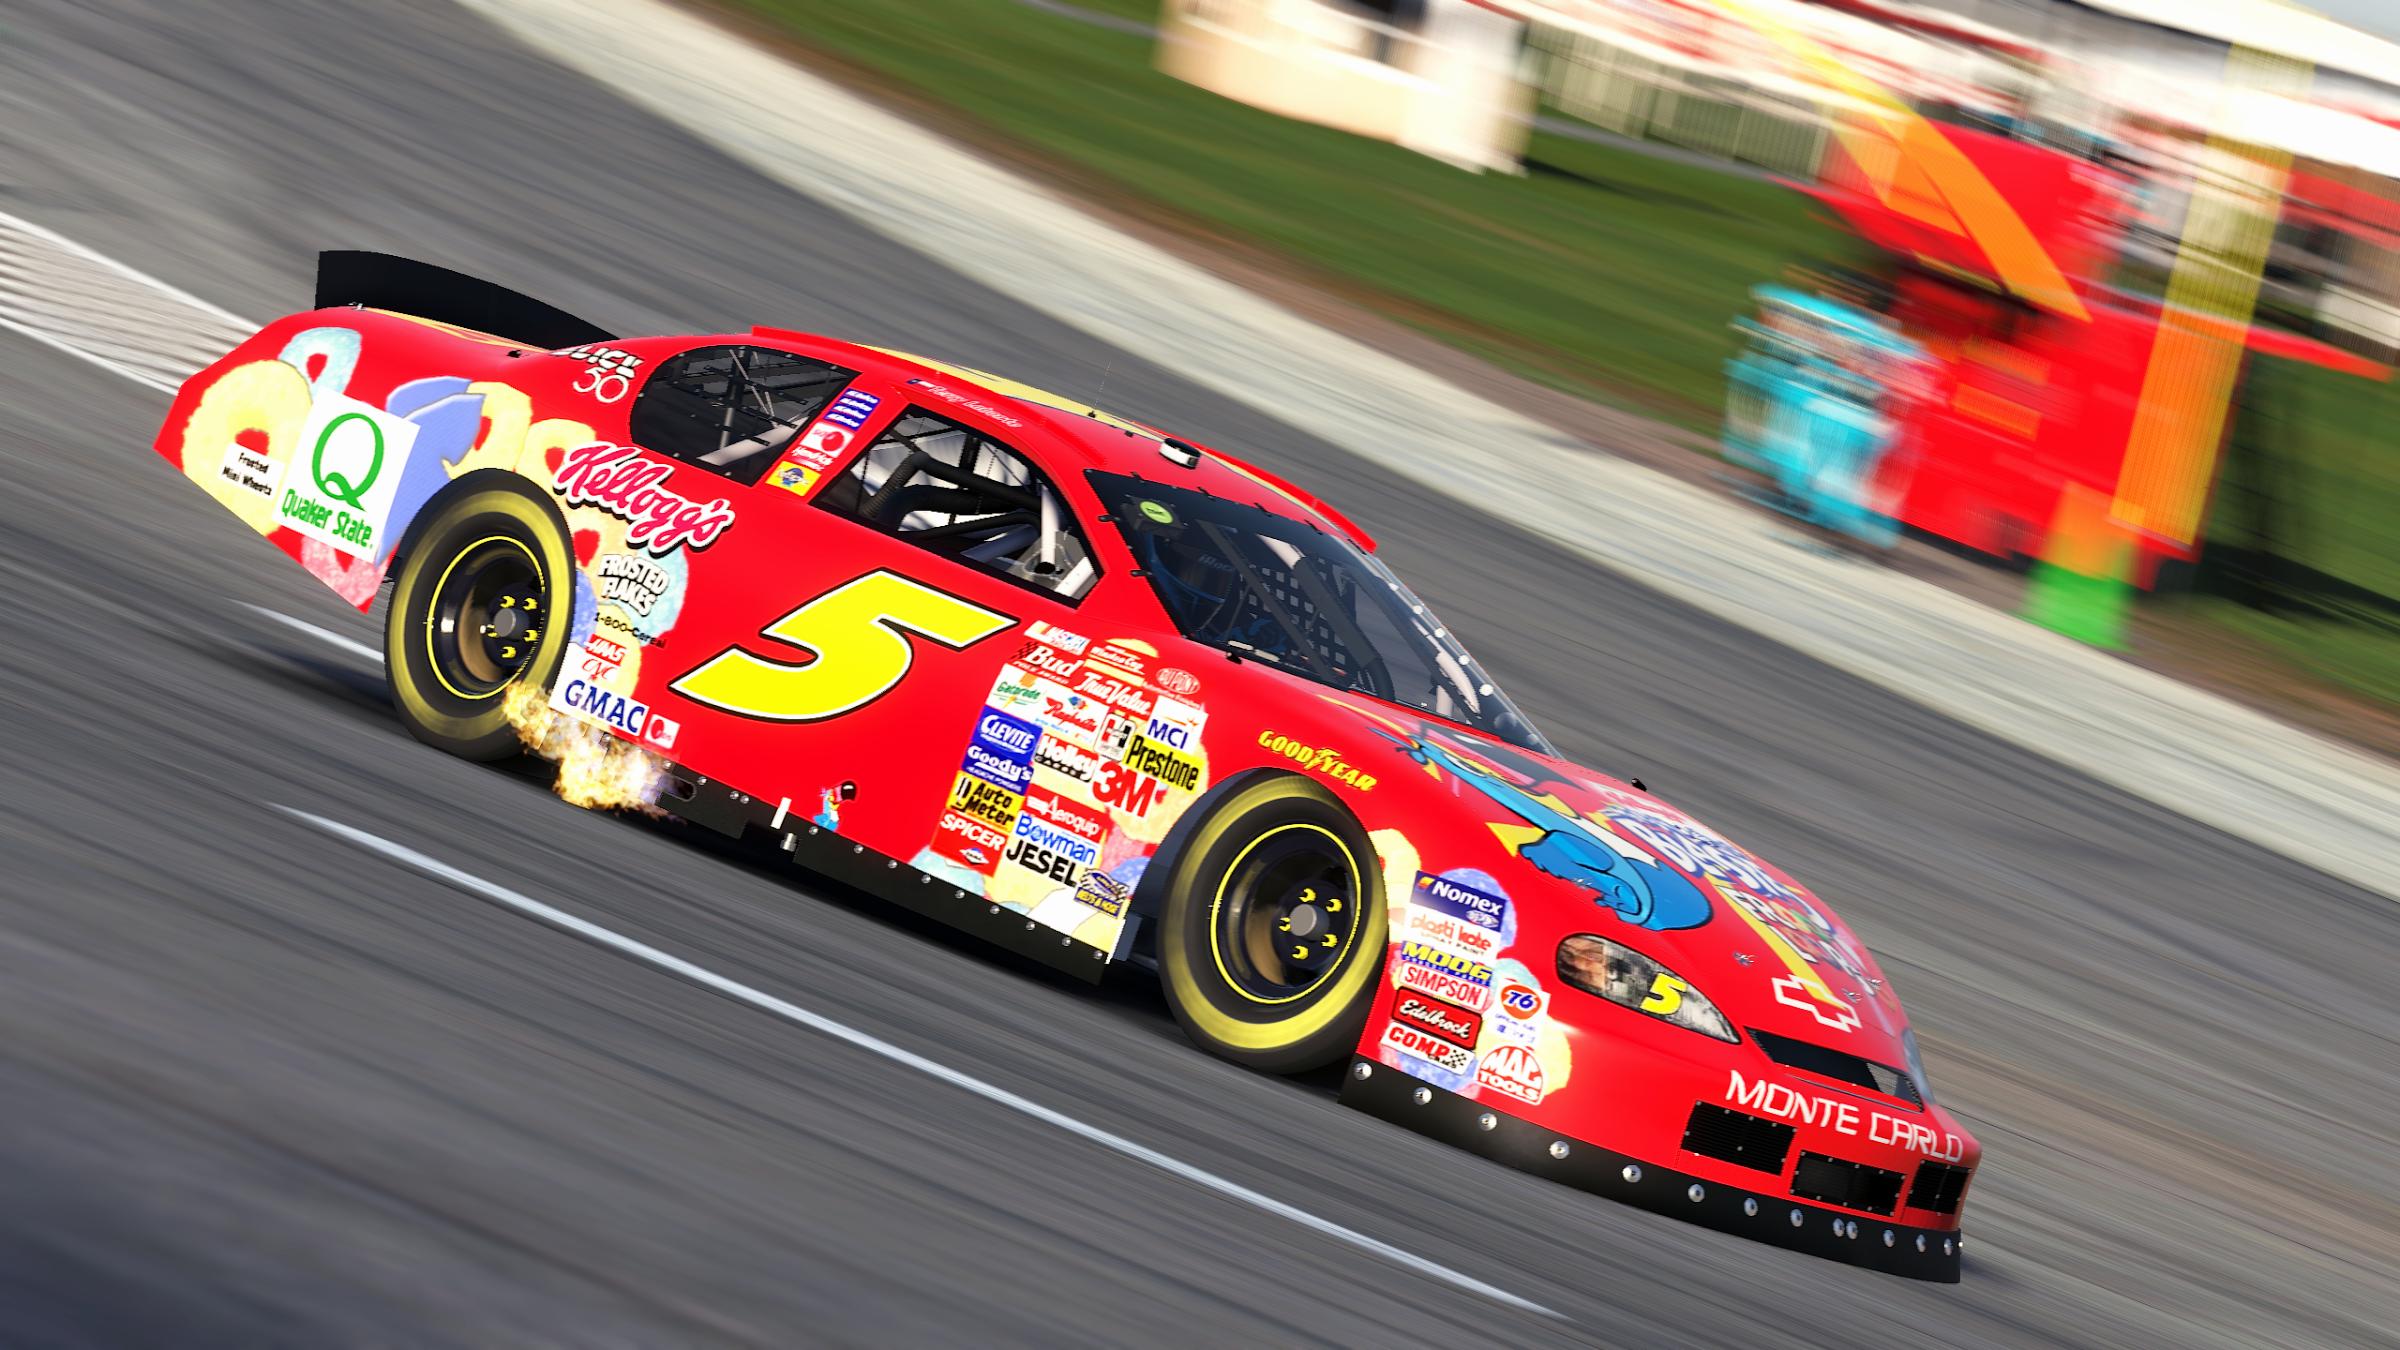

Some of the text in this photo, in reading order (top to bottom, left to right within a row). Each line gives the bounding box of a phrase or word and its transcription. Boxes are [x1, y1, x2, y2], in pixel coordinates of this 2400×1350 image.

[572, 366, 629, 403] 50
[312, 412, 384, 512] Q
[281, 487, 333, 530] Quaker
[554, 441, 735, 556] Kellogg's
[598, 554, 670, 596] FROSTED
[601, 578, 659, 617] FLAKES
[668, 567, 1020, 723] 5
[1024, 645, 1084, 678] Bud
[564, 679, 646, 733] GMAC
[997, 681, 1041, 700] Gatorade
[1072, 671, 1152, 715] True Value
[980, 714, 1036, 750] CLEVITE
[1147, 718, 1189, 750] MCI
[967, 744, 1034, 782] Goody's
[1036, 734, 1097, 782] Holley
[1125, 734, 1200, 791] Prestone
[973, 780, 1013, 810] Auto
[1092, 760, 1158, 818] 3M
[967, 794, 1015, 827] Meter
[1044, 794, 1101, 836] Aeroquip
[939, 813, 1006, 851] SPICER
[1015, 813, 1097, 865] Bowman
[1006, 839, 1077, 888] JESEL
[1432, 881, 1505, 916] Nomex
[1402, 941, 1493, 980] MOOG
[1405, 966, 1482, 1006] SIMPSON
[1508, 991, 1536, 1011] 76
[1640, 971, 1688, 1015] 5
[1399, 999, 1471, 1039] Edelbrock
[1388, 1026, 1450, 1058] COMP
[1481, 1047, 1543, 1083] MAC
[1478, 1071, 1540, 1101] TOOLS
[1725, 1069, 1963, 1163] MONTE CARLO
